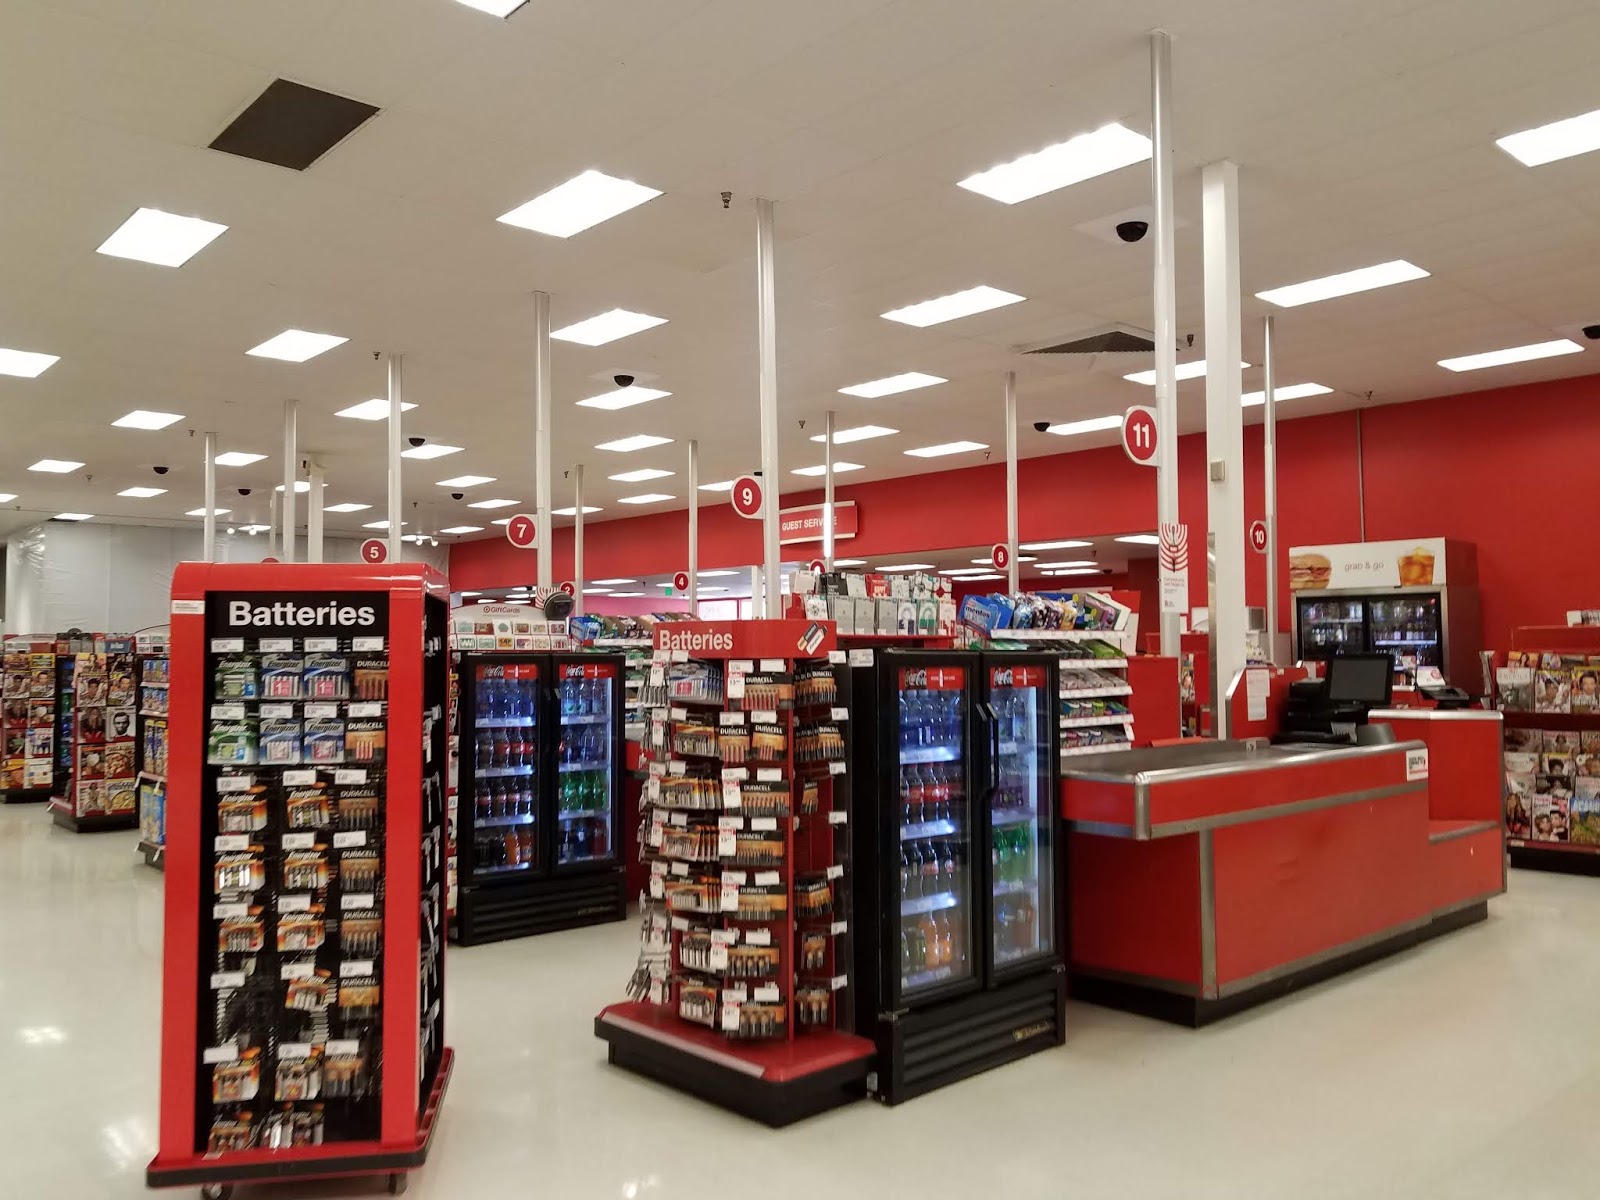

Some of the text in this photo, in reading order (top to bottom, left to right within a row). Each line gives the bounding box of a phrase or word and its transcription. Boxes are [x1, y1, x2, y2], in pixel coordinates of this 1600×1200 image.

[1132, 422, 1150, 449] 11
[742, 487, 753, 506] 9
[781, 516, 838, 531] GUEST SERVE
[516, 523, 528, 539] 7
[1254, 529, 1265, 545] 10
[369, 546, 380, 559] 5
[997, 550, 1004, 563] 8
[1344, 562, 1363, 573] grab
[1373, 562, 1385, 572] go
[678, 577, 685, 587] 4
[564, 586, 571, 595] 2
[229, 600, 376, 627] Batteries
[490, 606, 521, 615] GiftCards
[965, 605, 990, 619] mentos
[659, 628, 734, 651] Batteries
[267, 660, 300, 669] Energizer
[309, 659, 342, 668] Energizer
[356, 660, 389, 668] DURACELL
[745, 676, 774, 684] DURACELL
[264, 724, 297, 733] Energizer
[308, 723, 342, 732] Energizer
[347, 722, 384, 730] DURACELL
[720, 727, 748, 735] DURACELL
[755, 724, 783, 735] DURACELL
[743, 784, 772, 792] DURACELL
